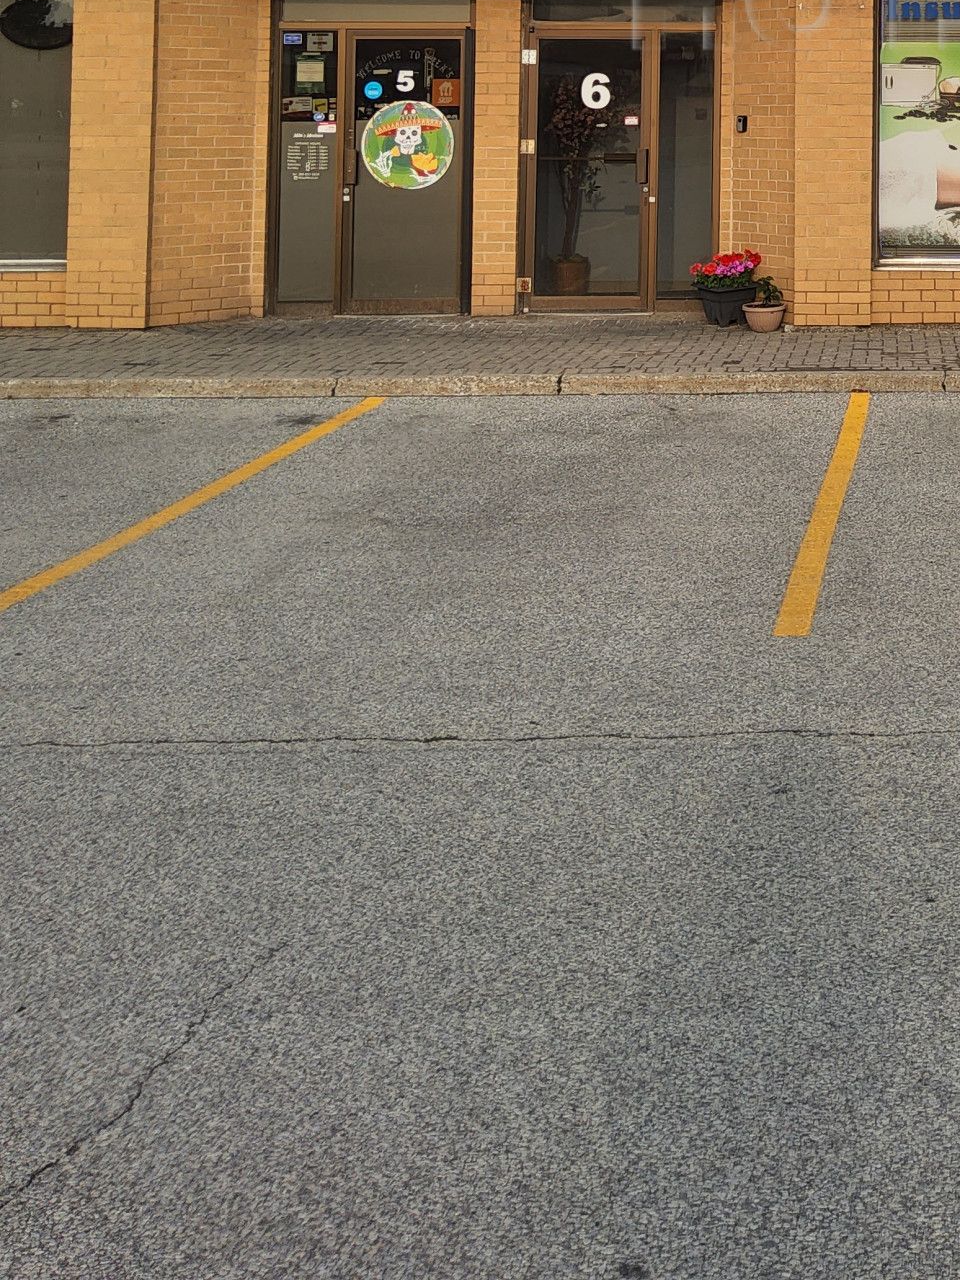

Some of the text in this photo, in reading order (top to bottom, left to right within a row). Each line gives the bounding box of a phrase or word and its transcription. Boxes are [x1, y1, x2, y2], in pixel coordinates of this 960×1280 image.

[357, 50, 420, 79] WELCOME TO
[396, 70, 415, 92] 5
[581, 73, 611, 109] 6
